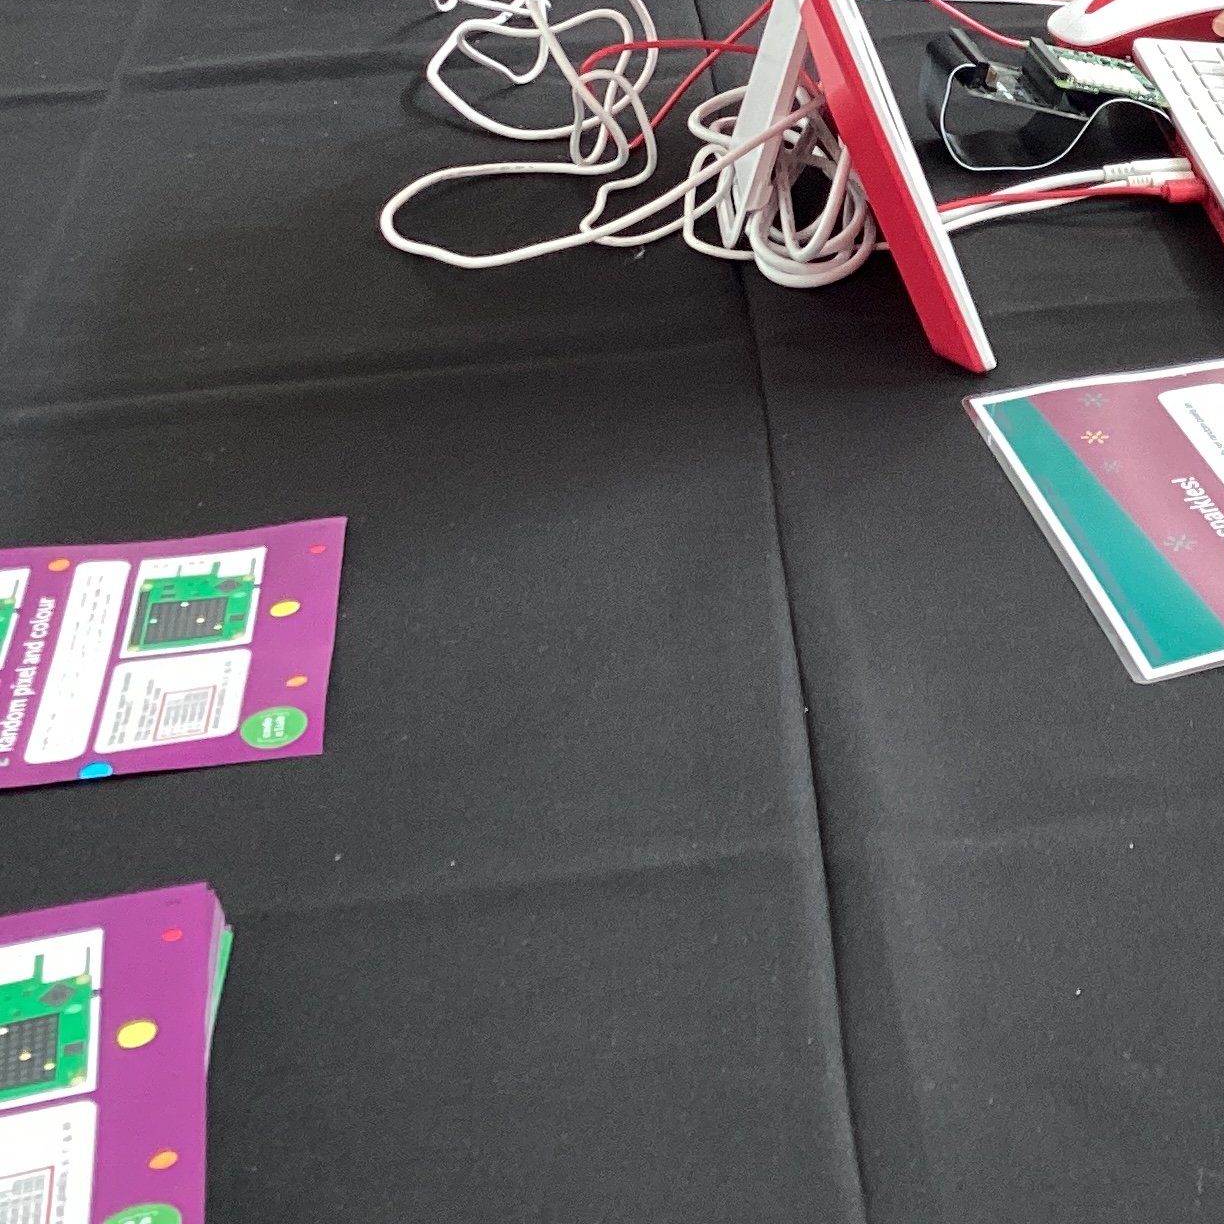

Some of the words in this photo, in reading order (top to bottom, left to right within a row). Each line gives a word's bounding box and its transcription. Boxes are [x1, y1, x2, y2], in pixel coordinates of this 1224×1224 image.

[29, 597, 56, 639] colour
[23, 640, 45, 665] and
[10, 666, 38, 696] pixel
